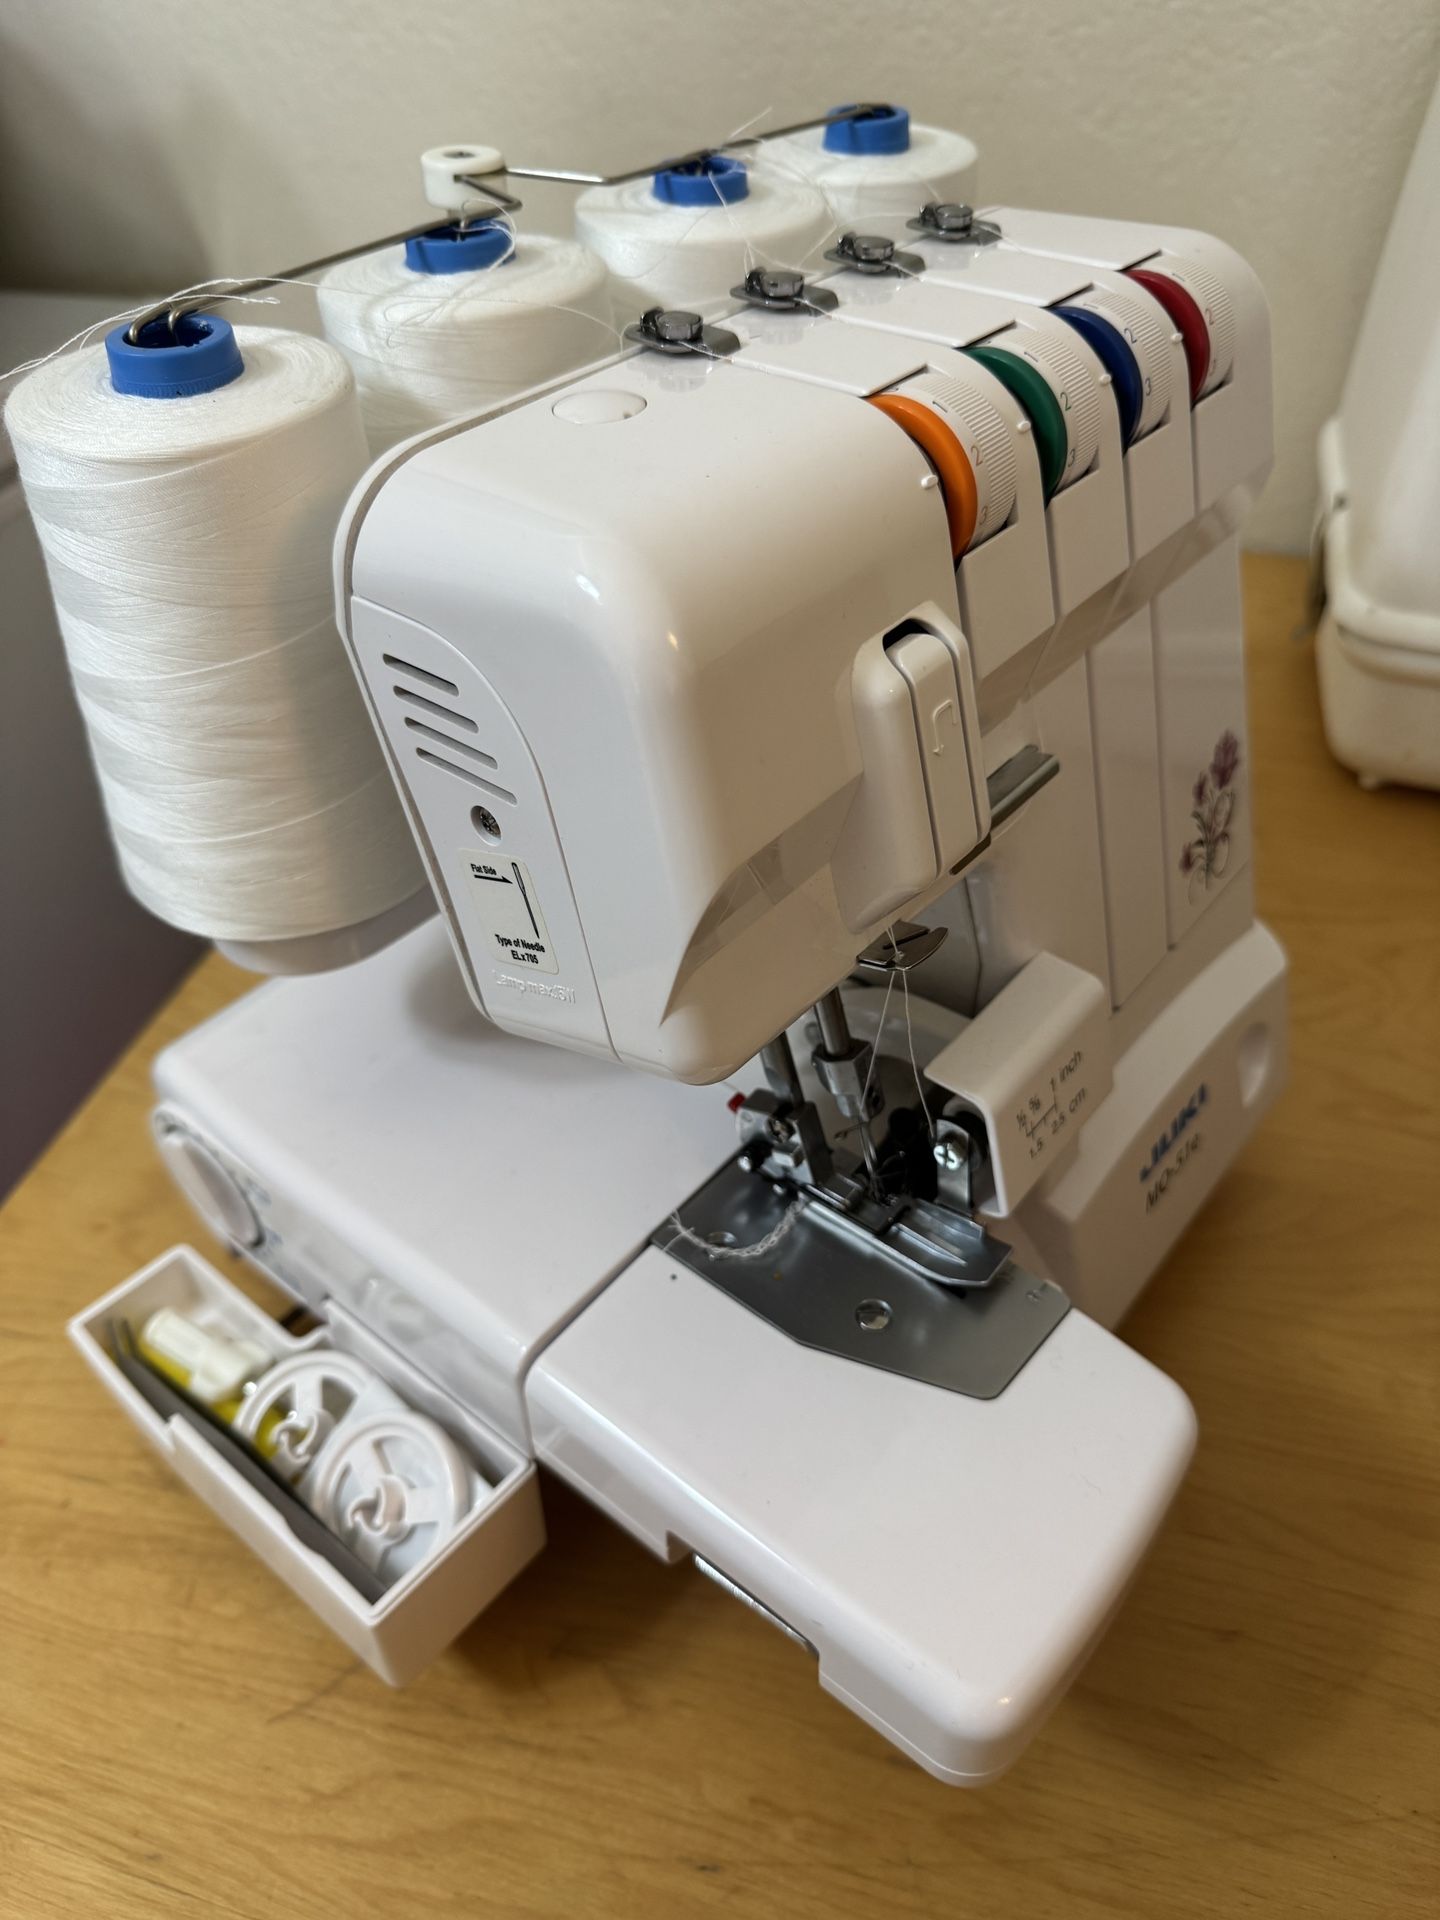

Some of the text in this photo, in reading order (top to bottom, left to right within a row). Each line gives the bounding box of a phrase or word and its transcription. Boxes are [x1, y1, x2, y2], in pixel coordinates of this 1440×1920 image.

[1204, 308, 1215, 326] 2
[1123, 327, 1138, 345] 2
[1144, 377, 1153, 396] 3
[1059, 391, 1073, 413] 2
[970, 444, 984, 466] 2
[1067, 448, 1077, 469] 3
[978, 505, 988, 526] 3
[470, 863, 497, 876] Flat Side
[495, 933, 546, 953] Type of Needle
[1058, 1050, 1083, 1083] inch
[1068, 1087, 1087, 1114] cm
[1139, 1082, 1209, 1184] JUKI
